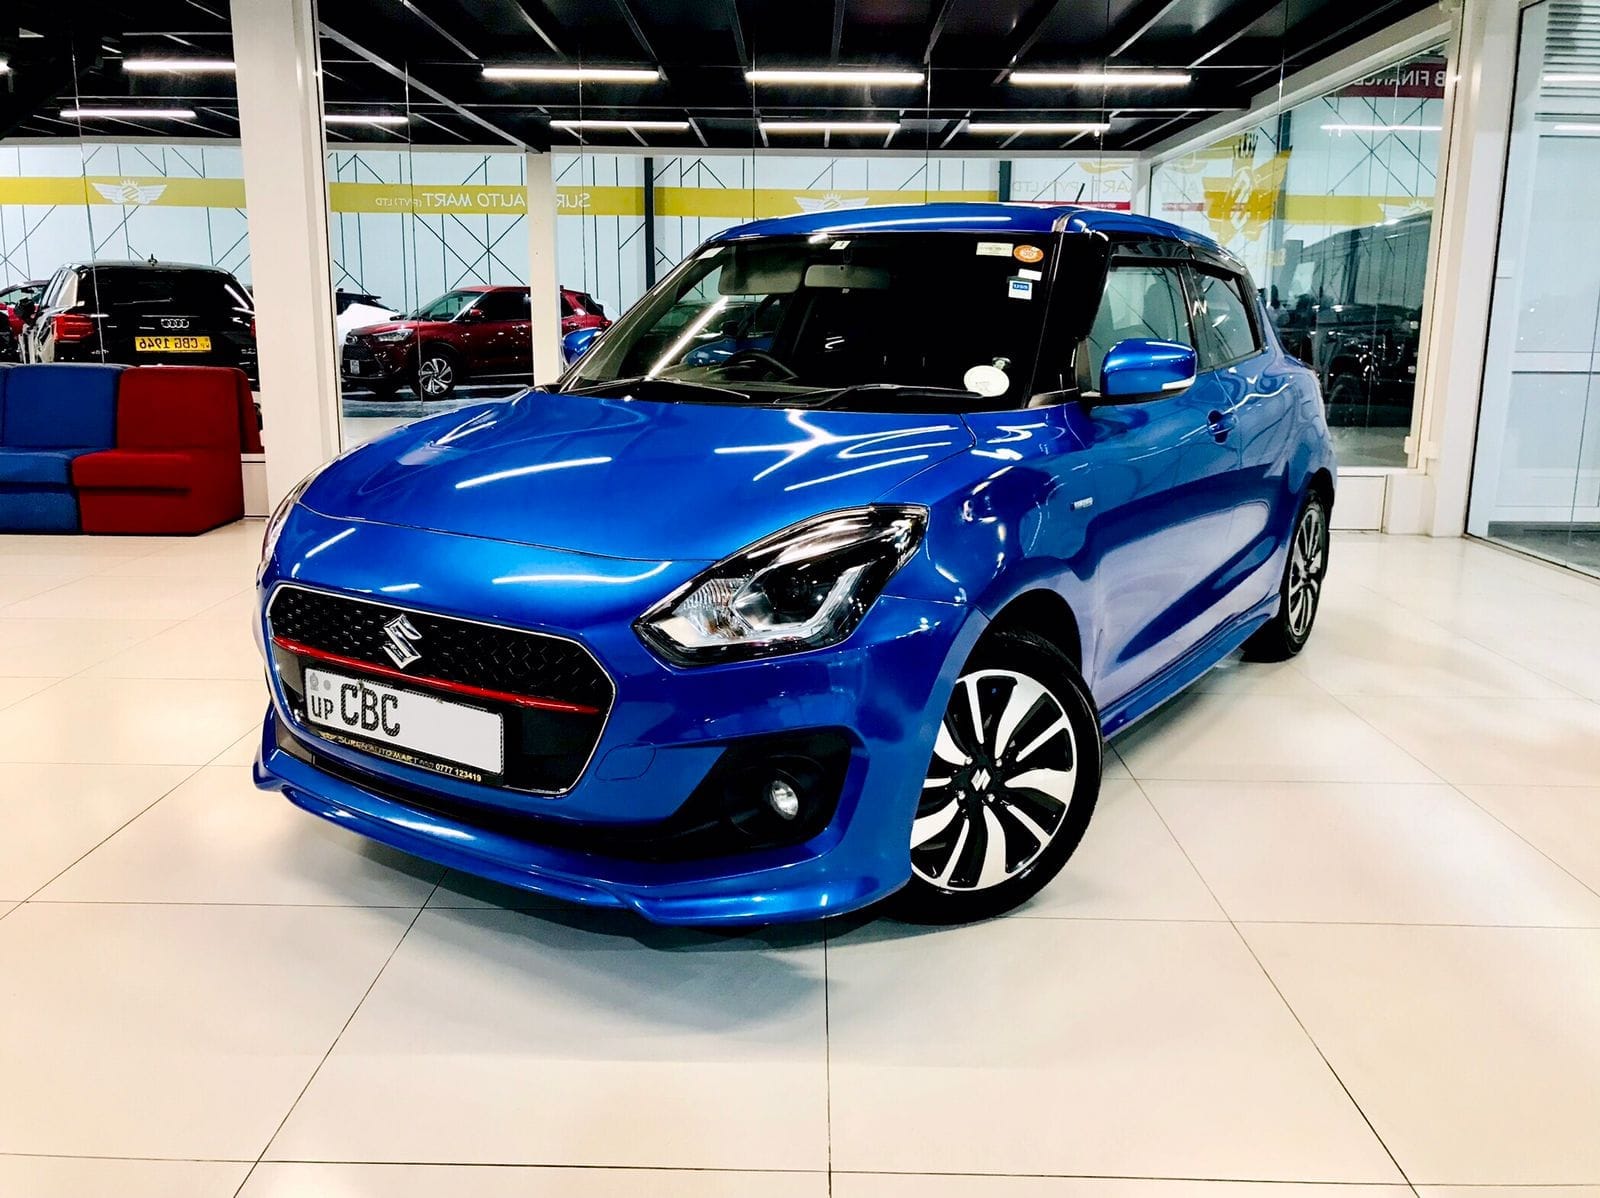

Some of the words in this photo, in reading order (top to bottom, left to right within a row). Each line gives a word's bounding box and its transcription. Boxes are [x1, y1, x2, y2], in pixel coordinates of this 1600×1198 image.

[311, 694, 334, 720] UP
[340, 683, 400, 737] CBC
[393, 751, 419, 764] MART
[435, 763, 453, 774] 0777
